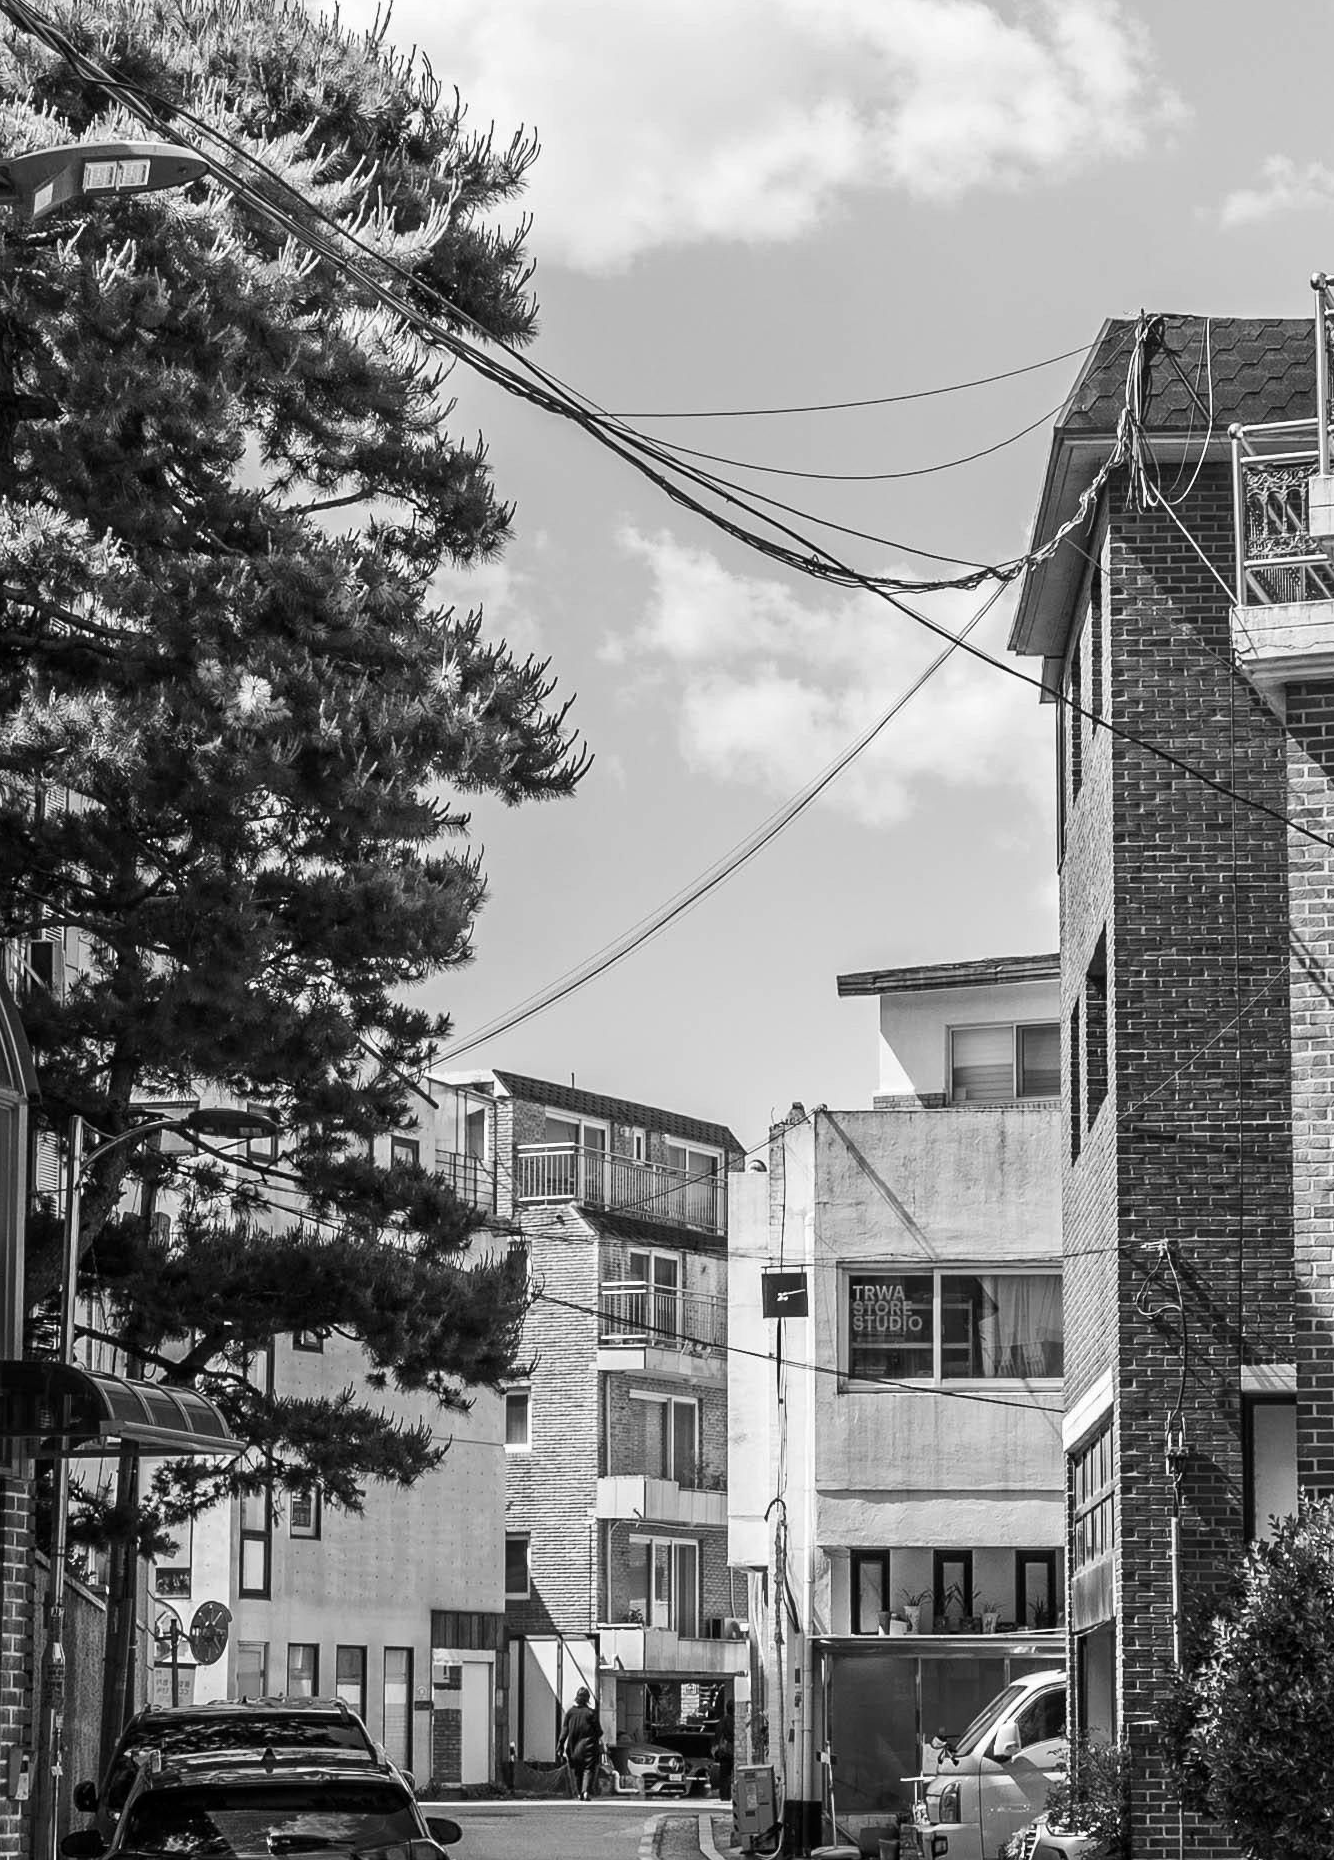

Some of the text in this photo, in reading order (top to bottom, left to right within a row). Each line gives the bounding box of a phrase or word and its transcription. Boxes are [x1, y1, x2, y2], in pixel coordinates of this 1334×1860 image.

[852, 1285, 905, 1300] TRWA
[853, 1301, 912, 1315] STORE
[853, 1316, 923, 1331] STUDIO
